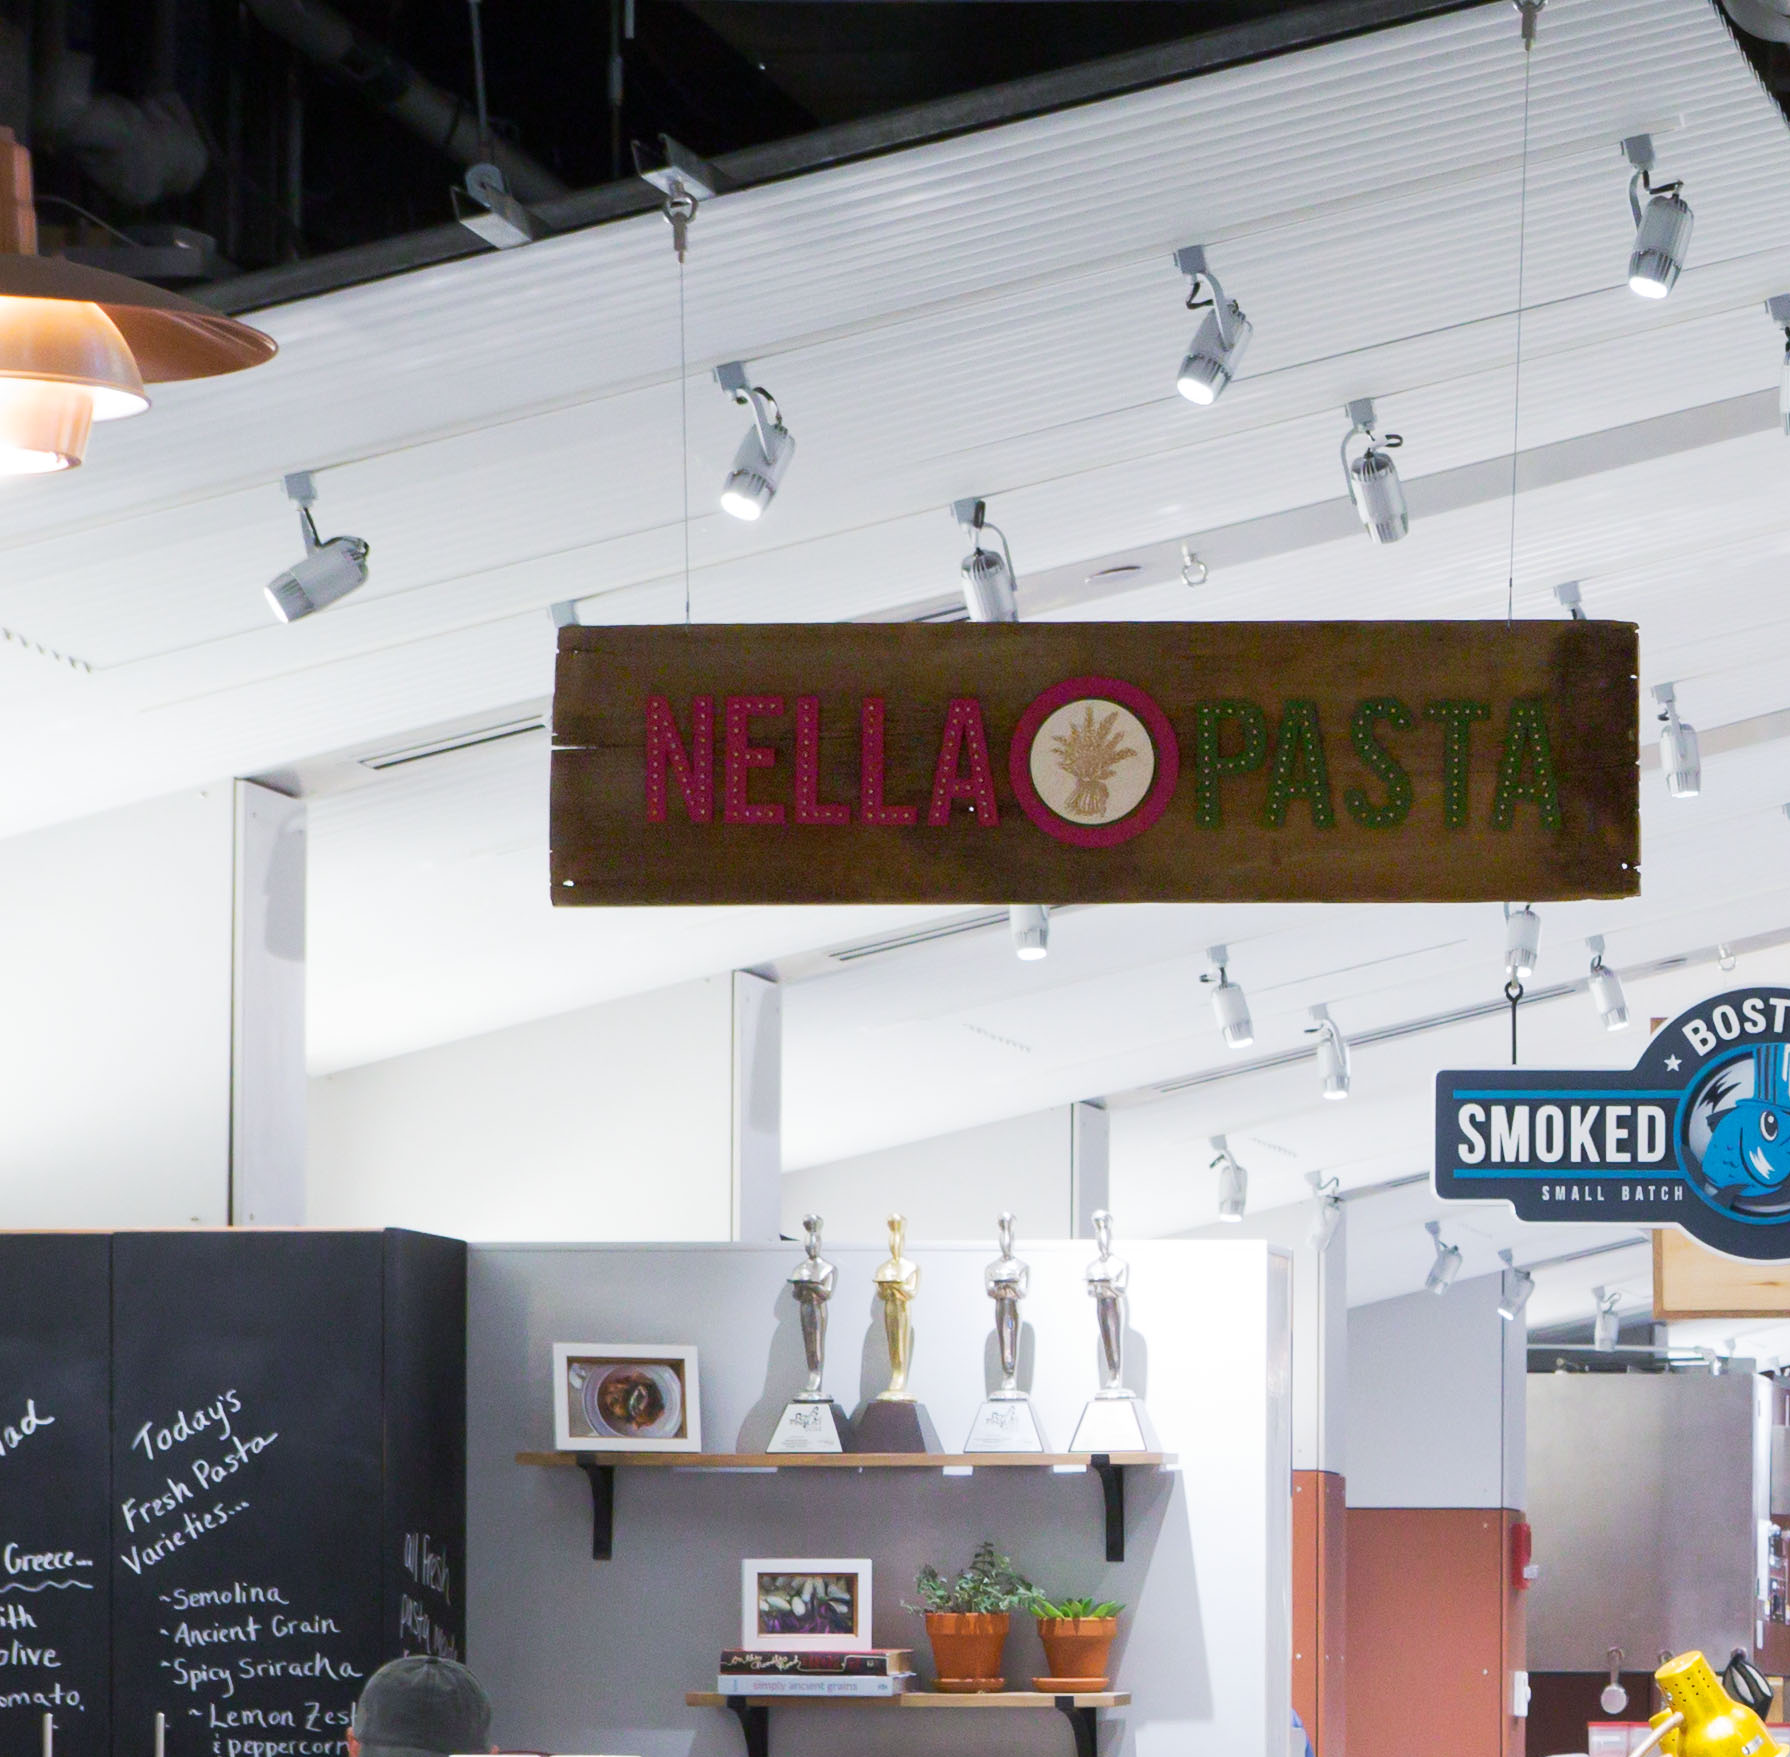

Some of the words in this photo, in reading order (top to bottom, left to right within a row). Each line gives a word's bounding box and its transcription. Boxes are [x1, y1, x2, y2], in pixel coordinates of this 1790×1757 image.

[645, 696, 999, 827] NELLA
[1200, 697, 1563, 830] PASTA
[1458, 1104, 1667, 1165] SMOKED
[1541, 1186, 1607, 1202] SMALL
[1621, 1186, 1684, 1202] BATCH
[131, 1389, 243, 1460] Today's
[121, 1477, 194, 1532] Fresh
[192, 1432, 279, 1489] Pasta
[173, 1582, 290, 1611] Semolina
[0, 1604, 38, 1630] ith
[173, 1616, 261, 1647] Ancient
[271, 1614, 341, 1638] Grain
[173, 1658, 234, 1698] Spicy
[239, 1652, 363, 1680] Sriracha
[753, 1680, 786, 1692] simply
[788, 1680, 825, 1691] ancient
[826, 1680, 858, 1692] grains
[209, 1702, 295, 1729] Lemon
